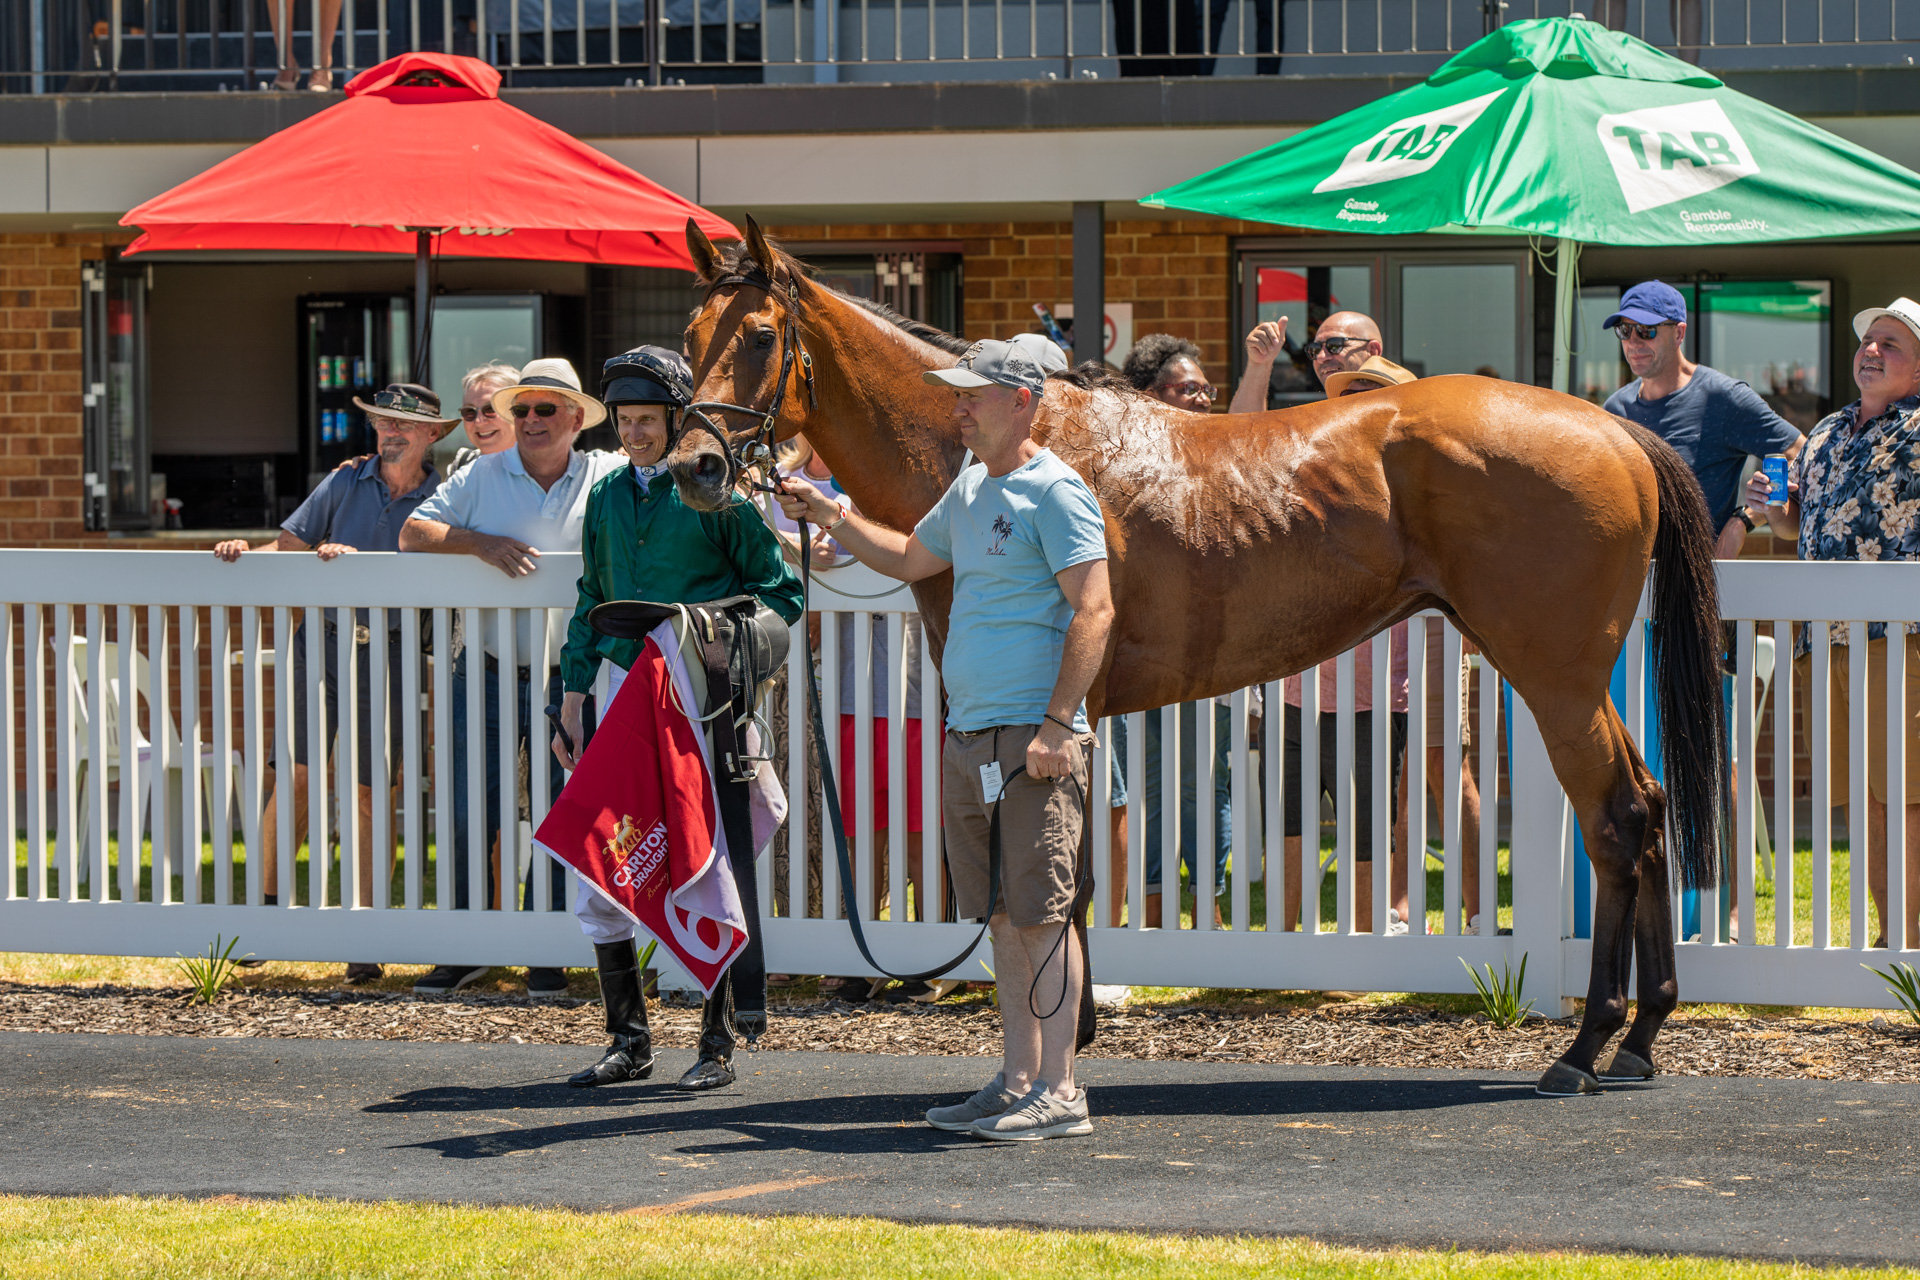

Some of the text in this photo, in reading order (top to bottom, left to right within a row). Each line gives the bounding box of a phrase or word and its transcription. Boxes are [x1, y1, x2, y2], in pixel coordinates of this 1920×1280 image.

[1366, 124, 1459, 162] TAB
[1612, 126, 1741, 170] TAB
[1680, 209, 1732, 222] Gamble
[1684, 219, 1770, 234] Responsibly.
[613, 821, 669, 887] CARLTON
[630, 839, 669, 890] DRAUGHT
[664, 887, 734, 965] 6
